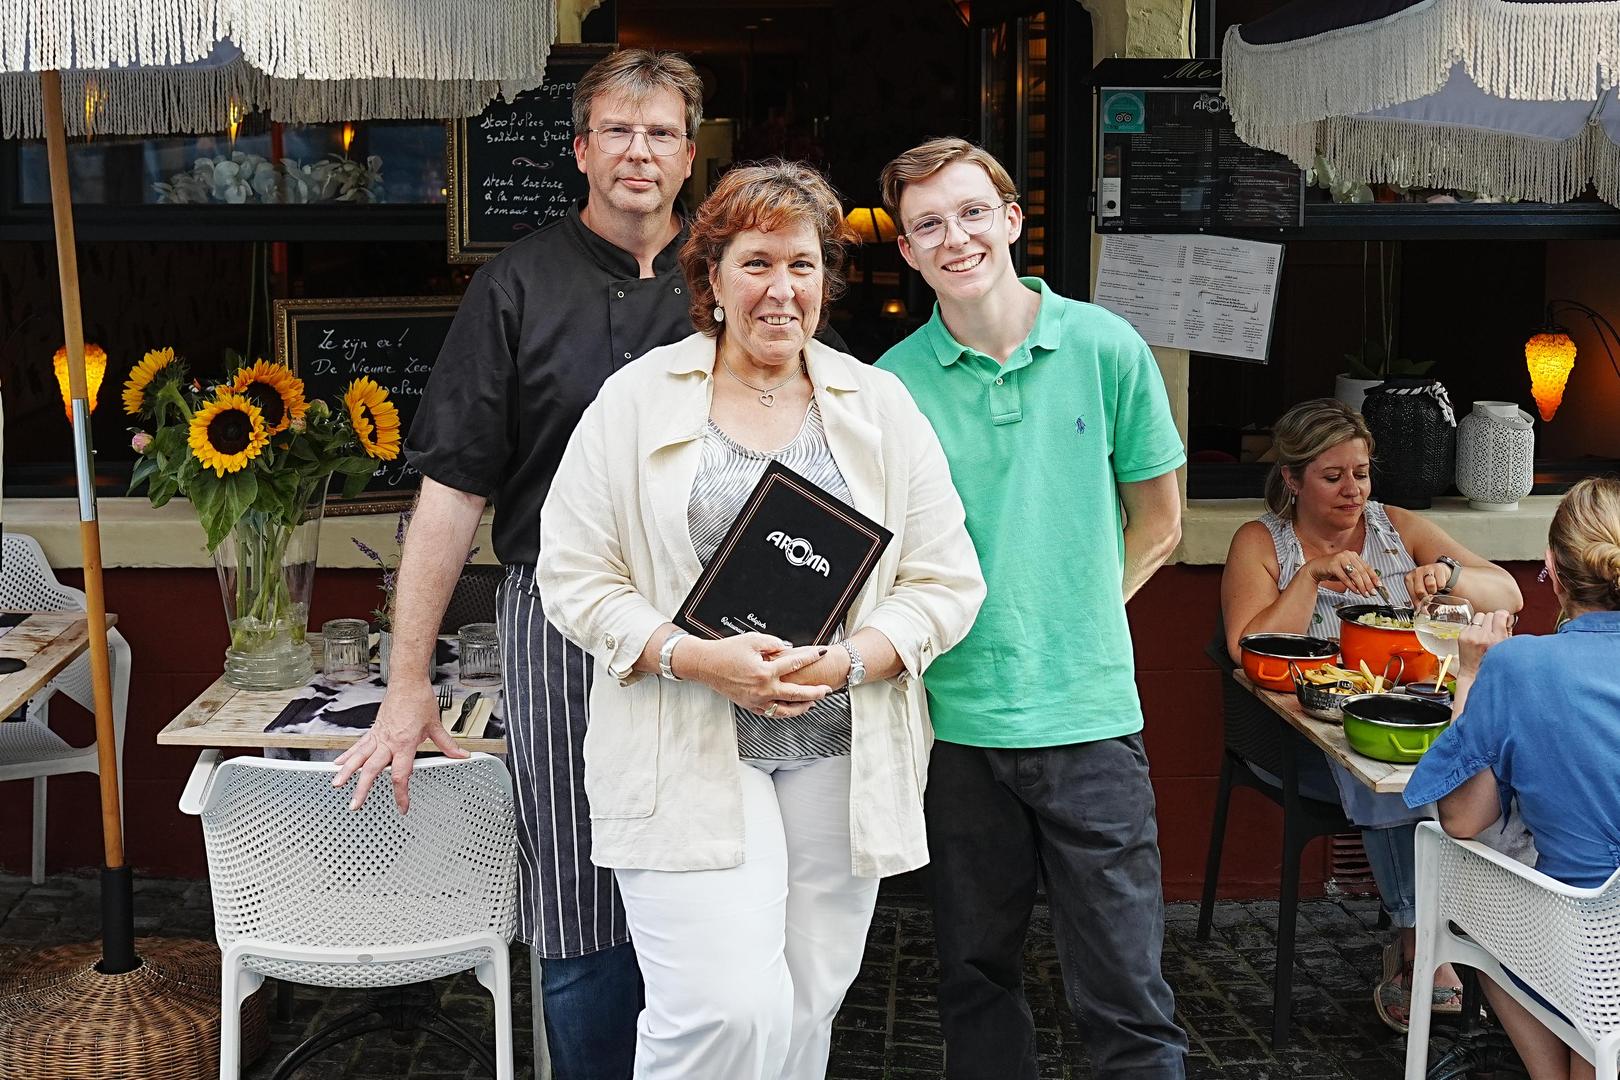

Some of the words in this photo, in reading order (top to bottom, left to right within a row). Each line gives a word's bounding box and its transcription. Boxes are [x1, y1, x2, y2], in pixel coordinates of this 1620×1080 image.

[541, 81, 577, 95] opper
[1192, 96, 1229, 113] AROM
[483, 173, 514, 187] steak
[342, 338, 368, 360] zijn
[311, 358, 338, 376] De
[348, 358, 396, 374] Nieuwe
[766, 531, 830, 577] AROMA
